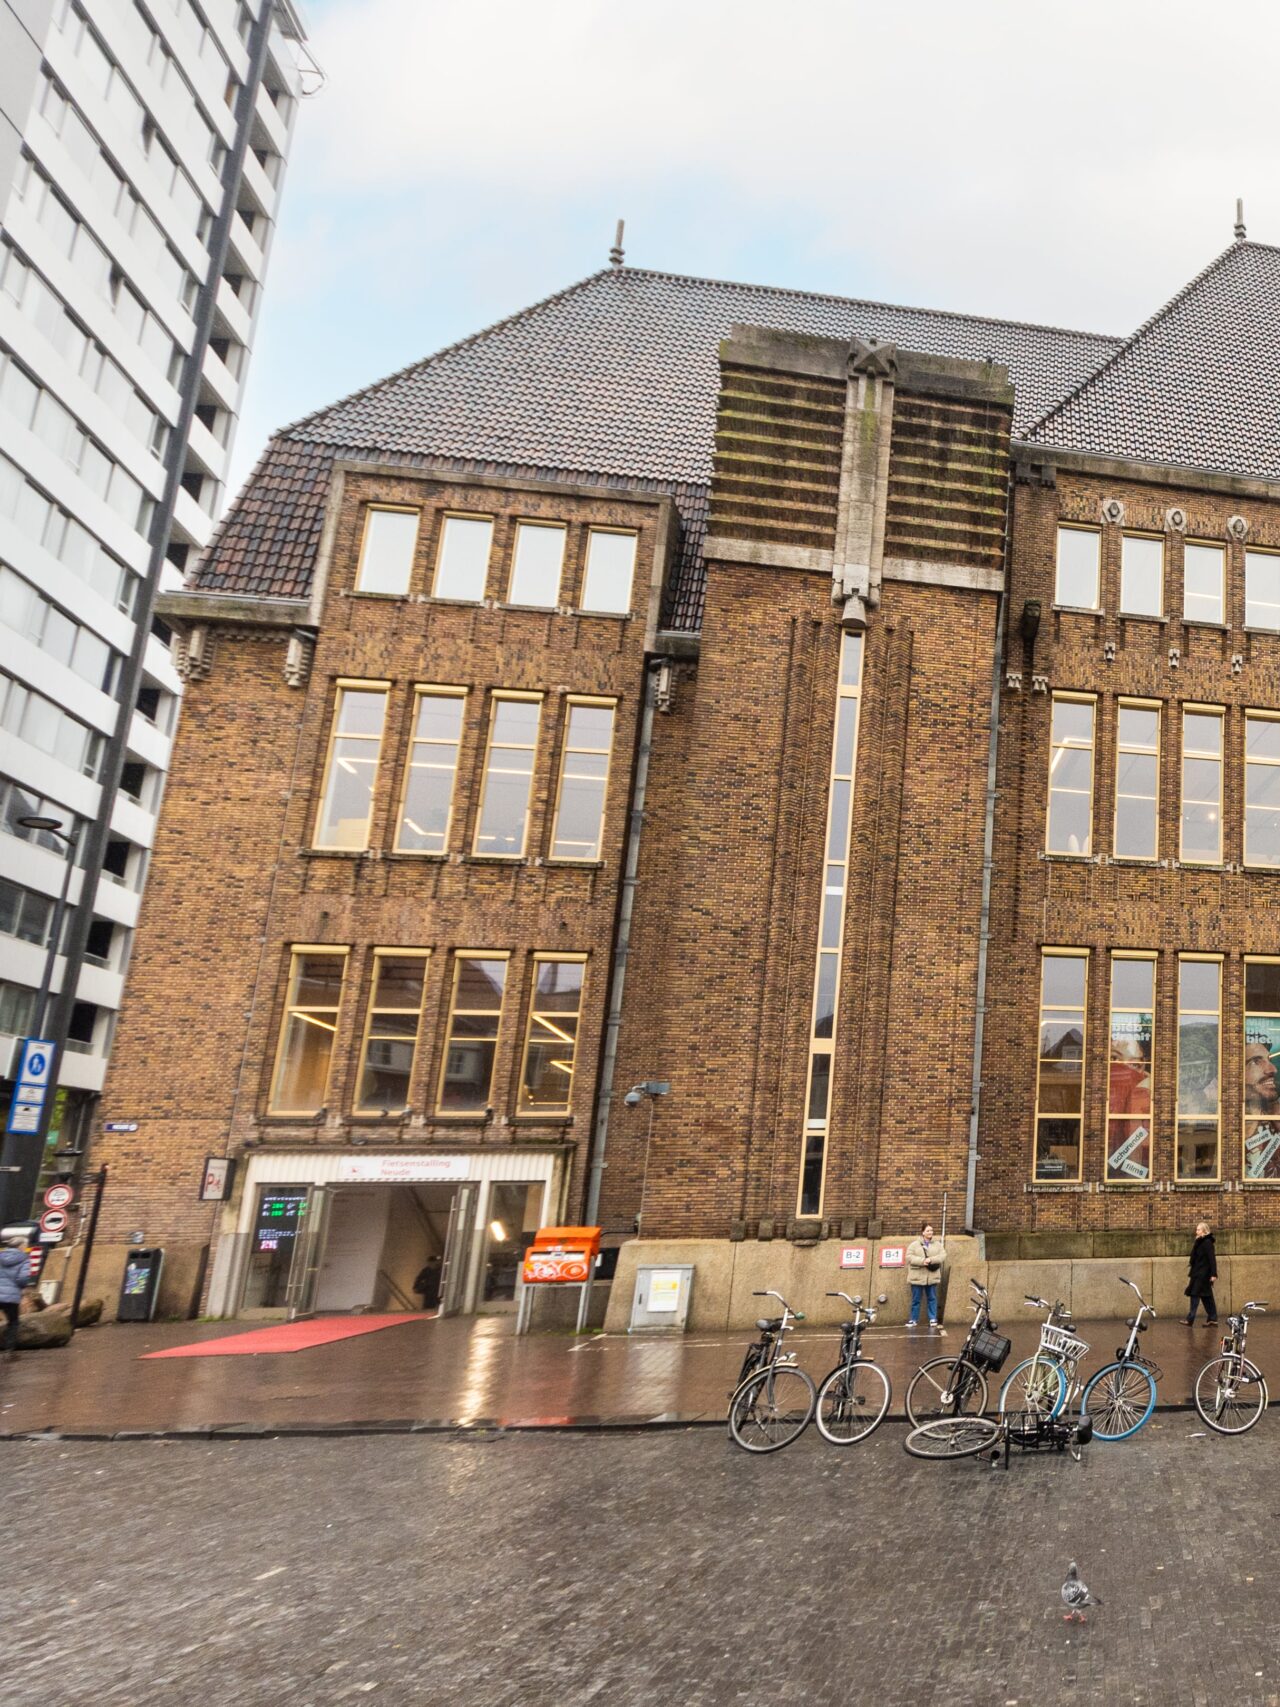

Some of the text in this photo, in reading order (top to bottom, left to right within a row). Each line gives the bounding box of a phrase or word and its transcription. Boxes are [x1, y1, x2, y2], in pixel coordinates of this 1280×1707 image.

[1248, 1133, 1269, 1147] nieuwe
[1113, 1131, 1144, 1164] schurende
[1253, 1137, 1280, 1175] ontmoetingen
[382, 1159, 451, 1168] Fietsenstalling
[1125, 1163, 1144, 1176] films
[845, 1251, 861, 1259] B-2
